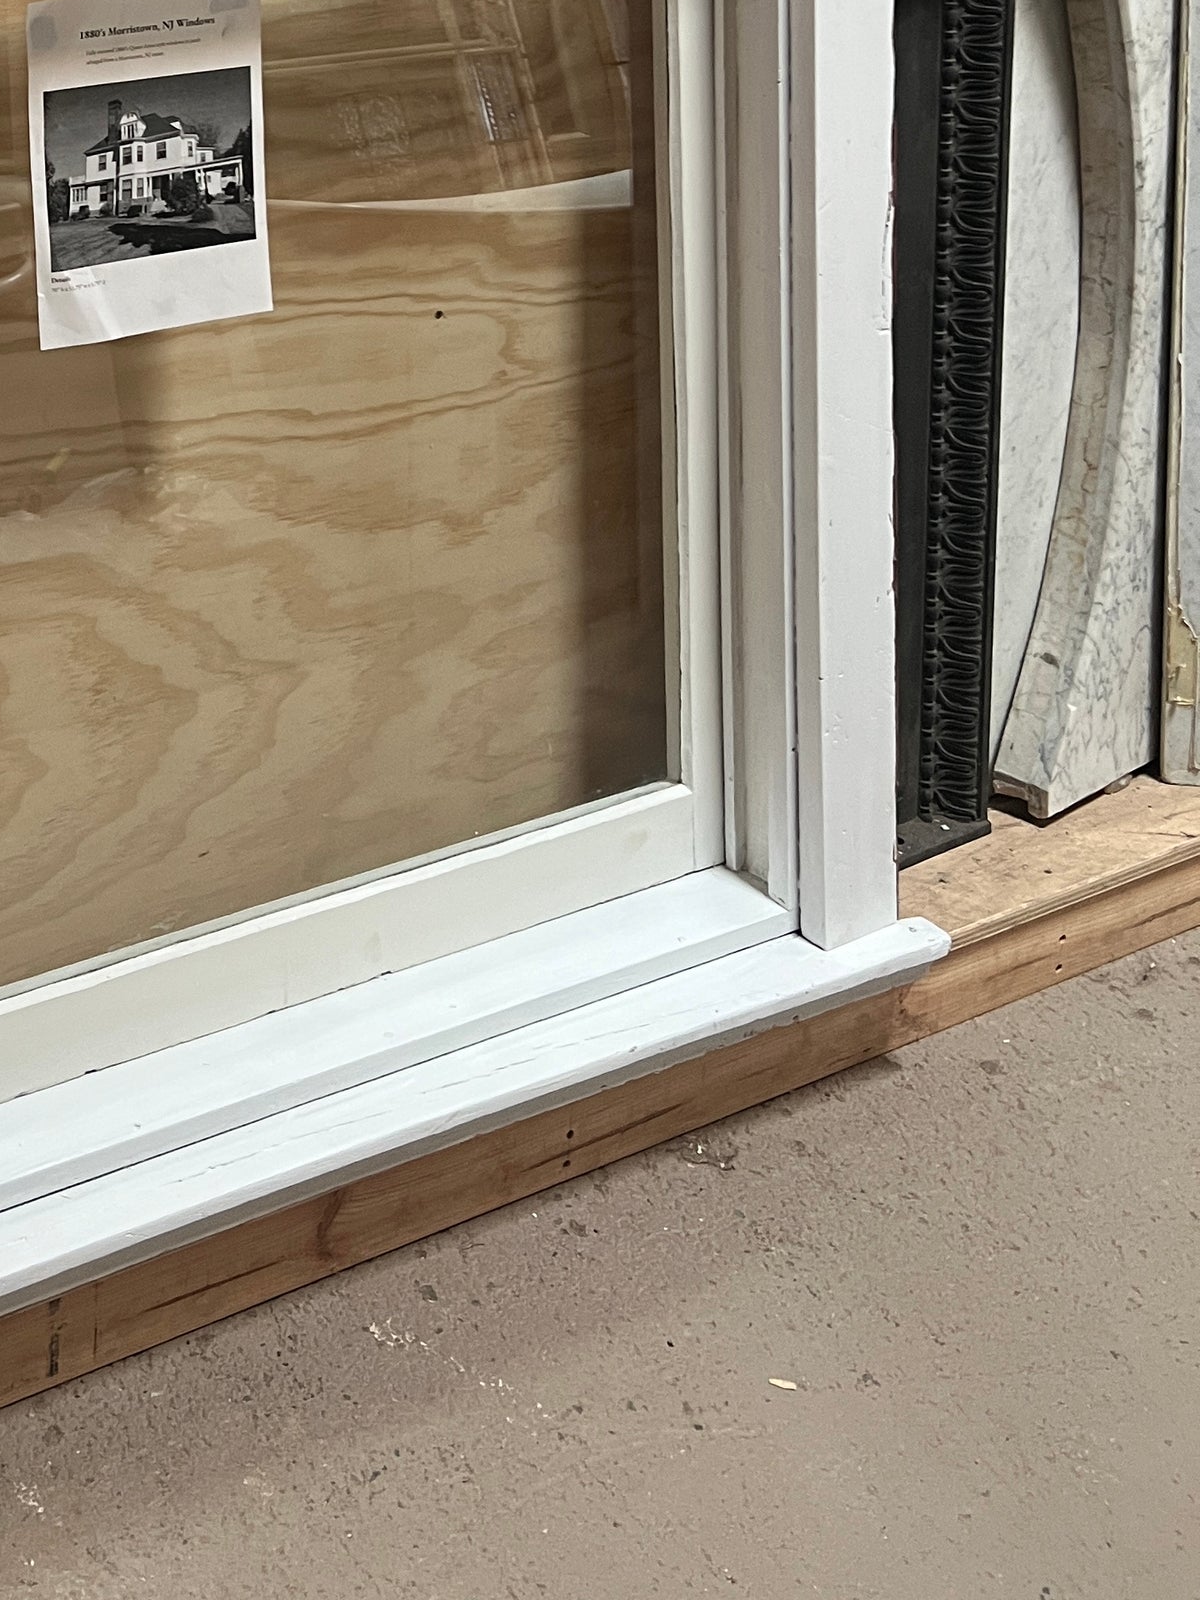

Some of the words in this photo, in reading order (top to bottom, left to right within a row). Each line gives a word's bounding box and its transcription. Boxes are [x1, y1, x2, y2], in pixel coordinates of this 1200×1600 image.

[107, 25, 160, 36] Morristown,
[162, 20, 174, 31] NJ
[176, 17, 215, 27] Windows
